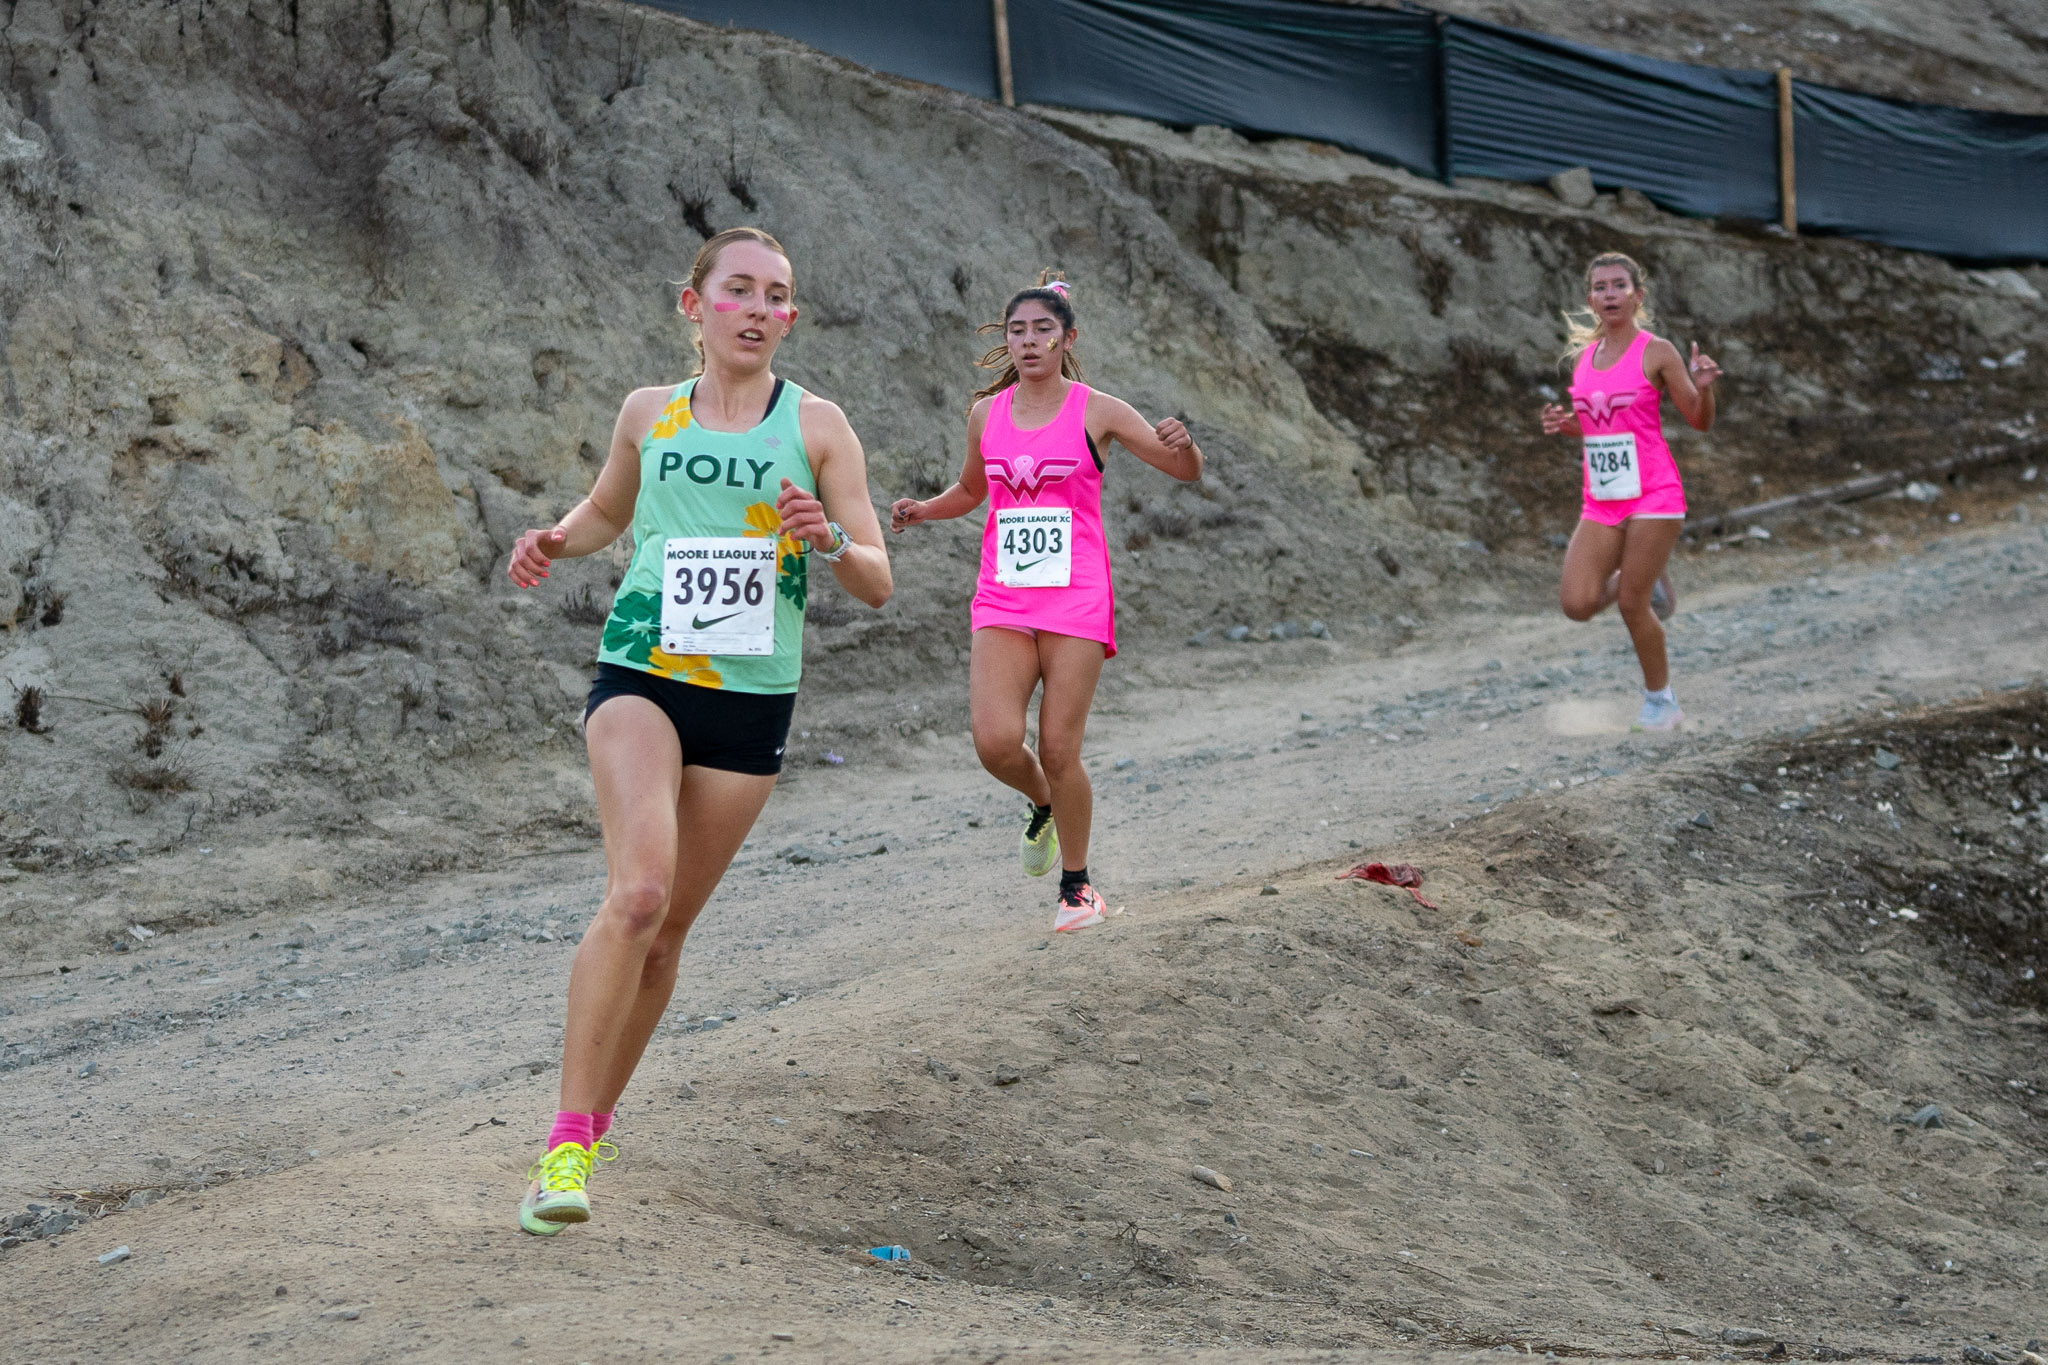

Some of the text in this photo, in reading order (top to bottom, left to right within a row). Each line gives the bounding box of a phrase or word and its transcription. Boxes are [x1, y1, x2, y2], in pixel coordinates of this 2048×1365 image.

[659, 452, 775, 490] POLY
[1591, 450, 1631, 472] 4284
[999, 516, 1025, 524] MOORE
[1004, 528, 1063, 554] 4303
[667, 550, 775, 560] MOORE LEAGUE XC
[673, 566, 764, 606] 3956
